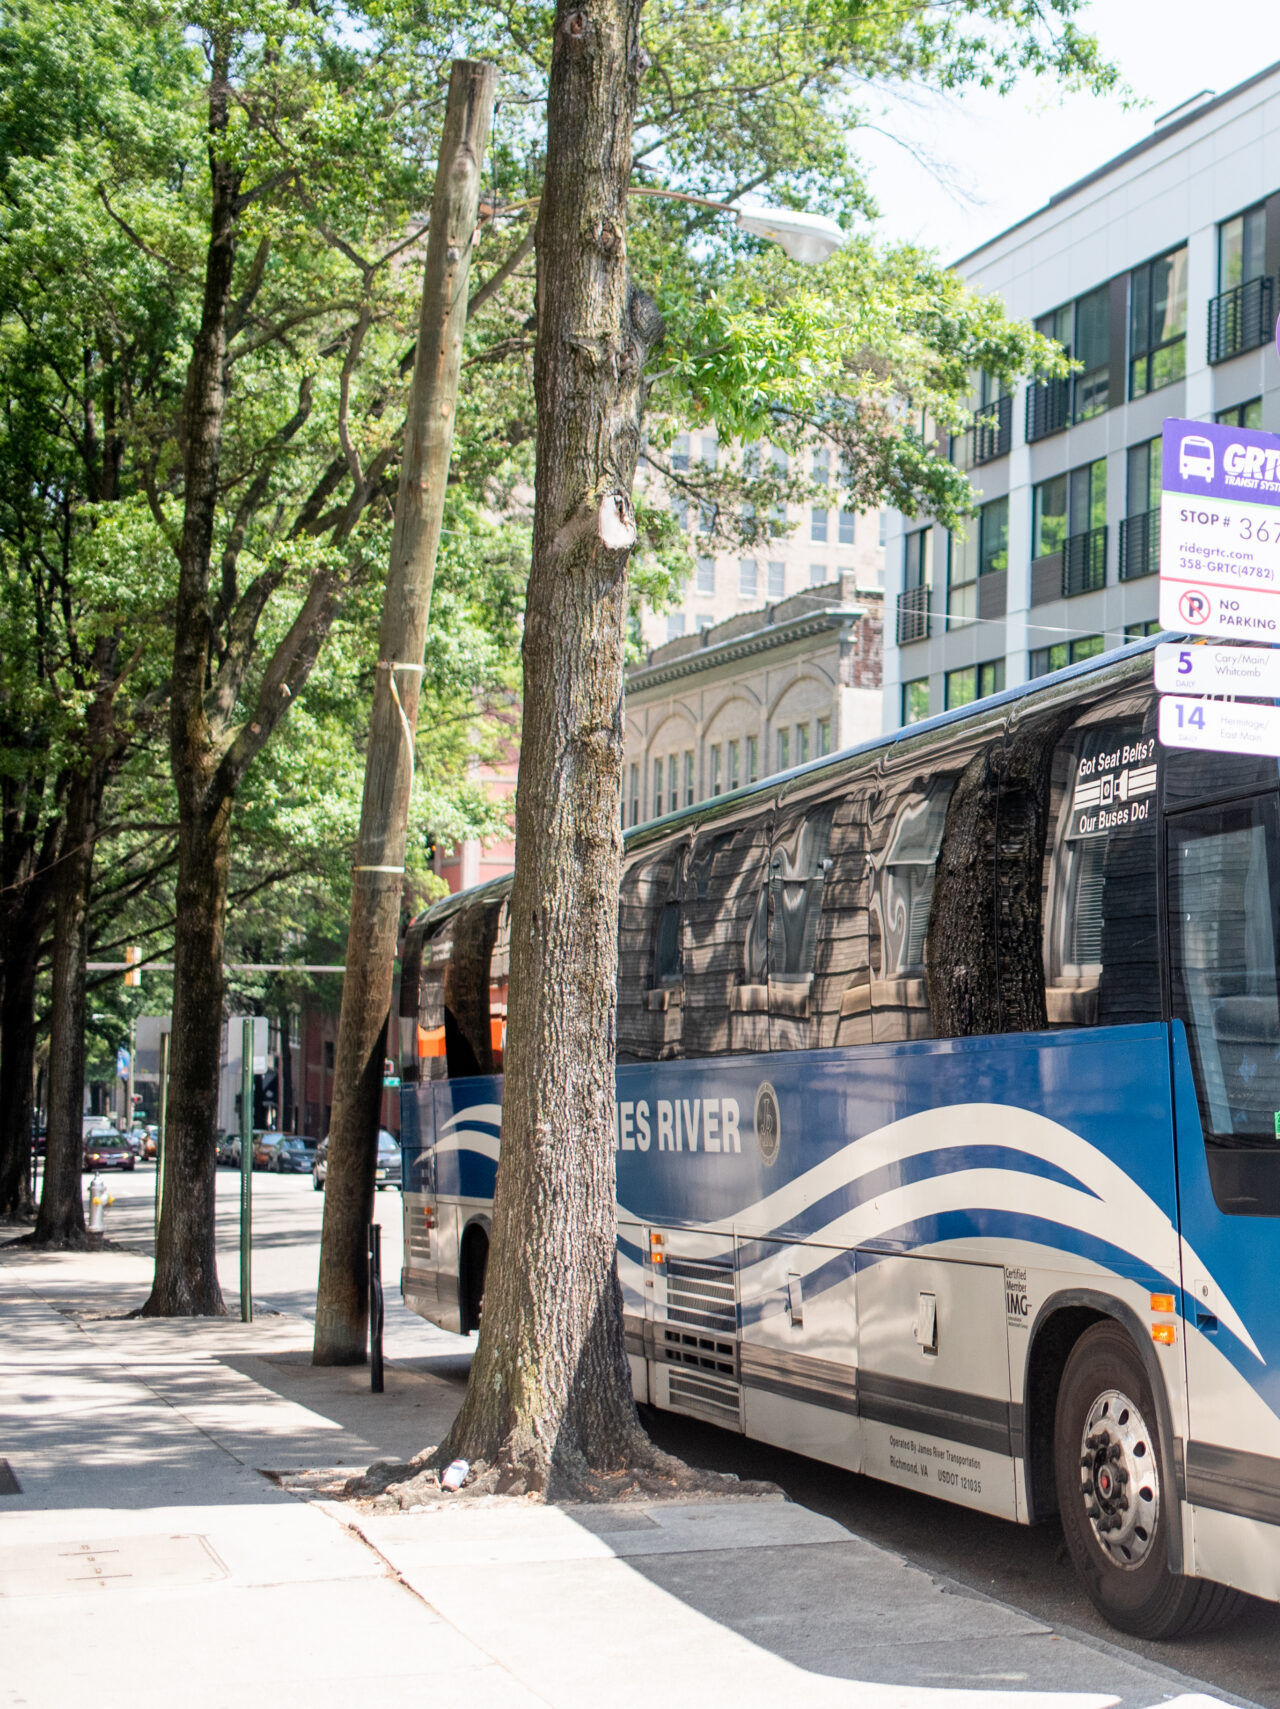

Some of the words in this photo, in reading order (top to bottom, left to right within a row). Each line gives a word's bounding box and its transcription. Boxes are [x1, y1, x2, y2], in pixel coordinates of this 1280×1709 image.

[1225, 475, 1258, 490] TRANSIT
[1180, 509, 1219, 526] STOP
[1223, 515, 1231, 528] #
[1179, 541, 1254, 560] ridegrtc.com
[1179, 557, 1275, 581] 358-GRTC(4782)
[1219, 599, 1240, 611] NO
[1219, 613, 1277, 630] PARKING
[1177, 651, 1193, 674] 5
[1215, 665, 1262, 678] Whitcomb
[1175, 704, 1206, 730] 14
[1079, 756, 1096, 776] Got
[1097, 749, 1121, 771] Seat
[1121, 739, 1155, 765] Belts?
[1079, 815, 1096, 833] Our
[1098, 808, 1129, 829] Buses
[1131, 800, 1149, 821] Do!
[657, 1098, 742, 1153] RIVER
[1006, 1280, 1027, 1293] Member
[1006, 1292, 1029, 1316] IMG
[889, 1434, 910, 1450] Operated
[910, 1440, 917, 1454] By
[918, 1442, 932, 1456] James
[933, 1446, 945, 1459] River
[946, 1450, 981, 1469] Transportation
[920, 1464, 928, 1477] VA
[937, 1469, 959, 1486] USDOT
[960, 1477, 982, 1493] 121035
